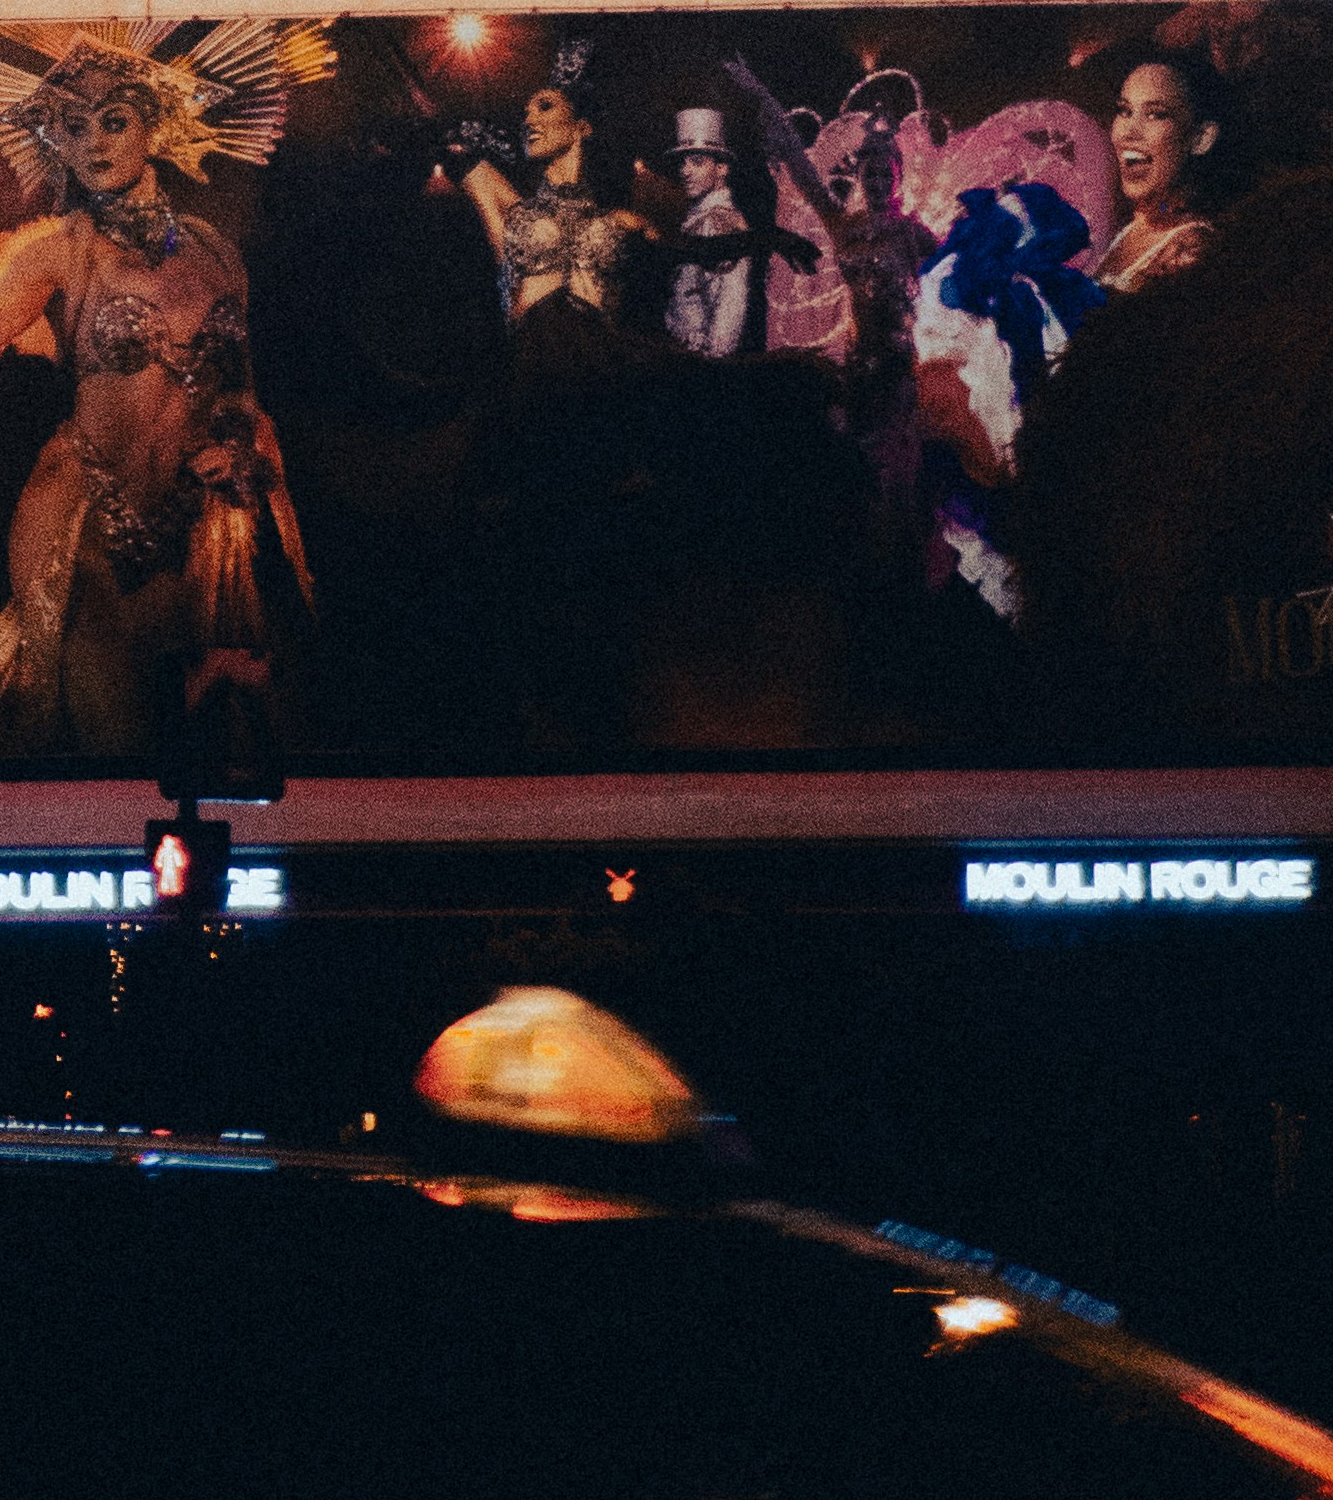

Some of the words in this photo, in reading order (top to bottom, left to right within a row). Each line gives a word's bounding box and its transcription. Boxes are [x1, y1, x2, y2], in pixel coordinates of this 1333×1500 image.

[122, 867, 283, 908] RGE
[966, 861, 1145, 901] MOULIN
[1149, 859, 1313, 900] ROUGE
